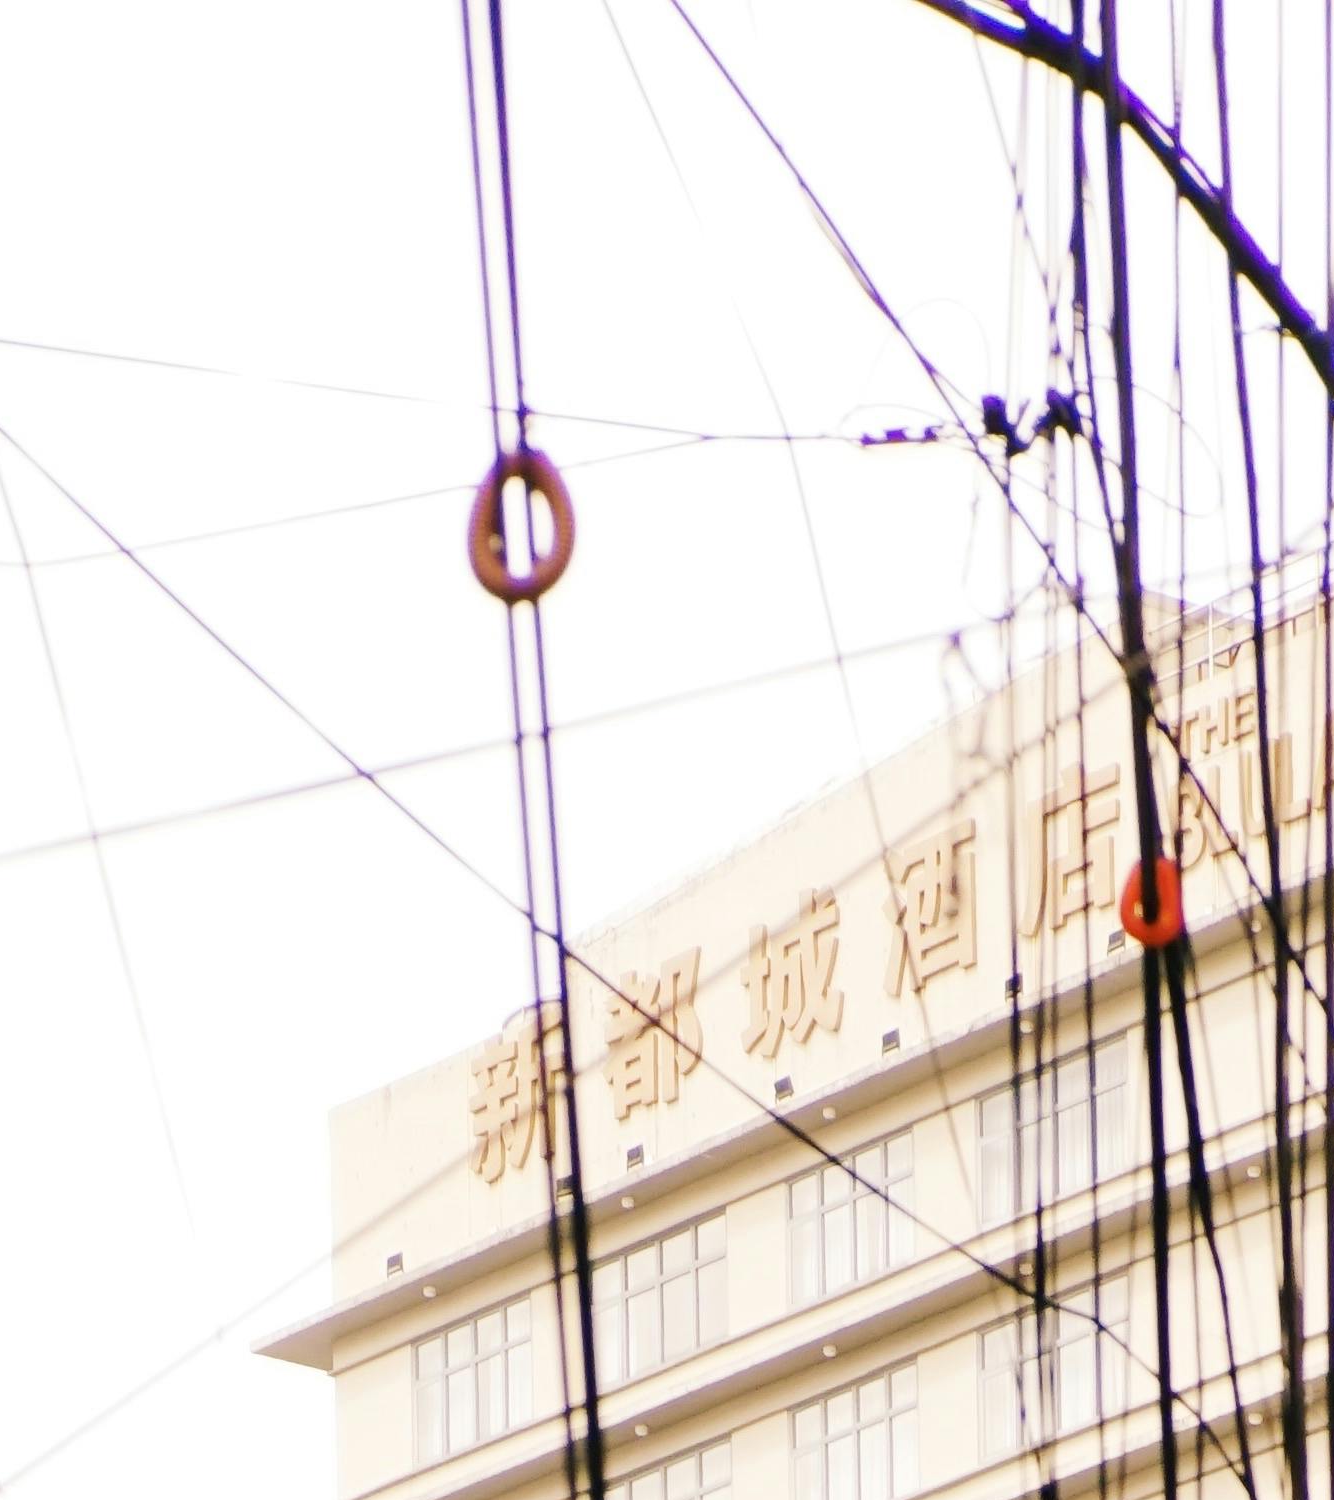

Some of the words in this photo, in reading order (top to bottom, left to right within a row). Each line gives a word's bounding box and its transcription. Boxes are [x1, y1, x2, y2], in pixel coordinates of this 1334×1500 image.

[1179, 686, 1257, 760] THE
[470, 763, 1119, 1183] 新都城酒店
